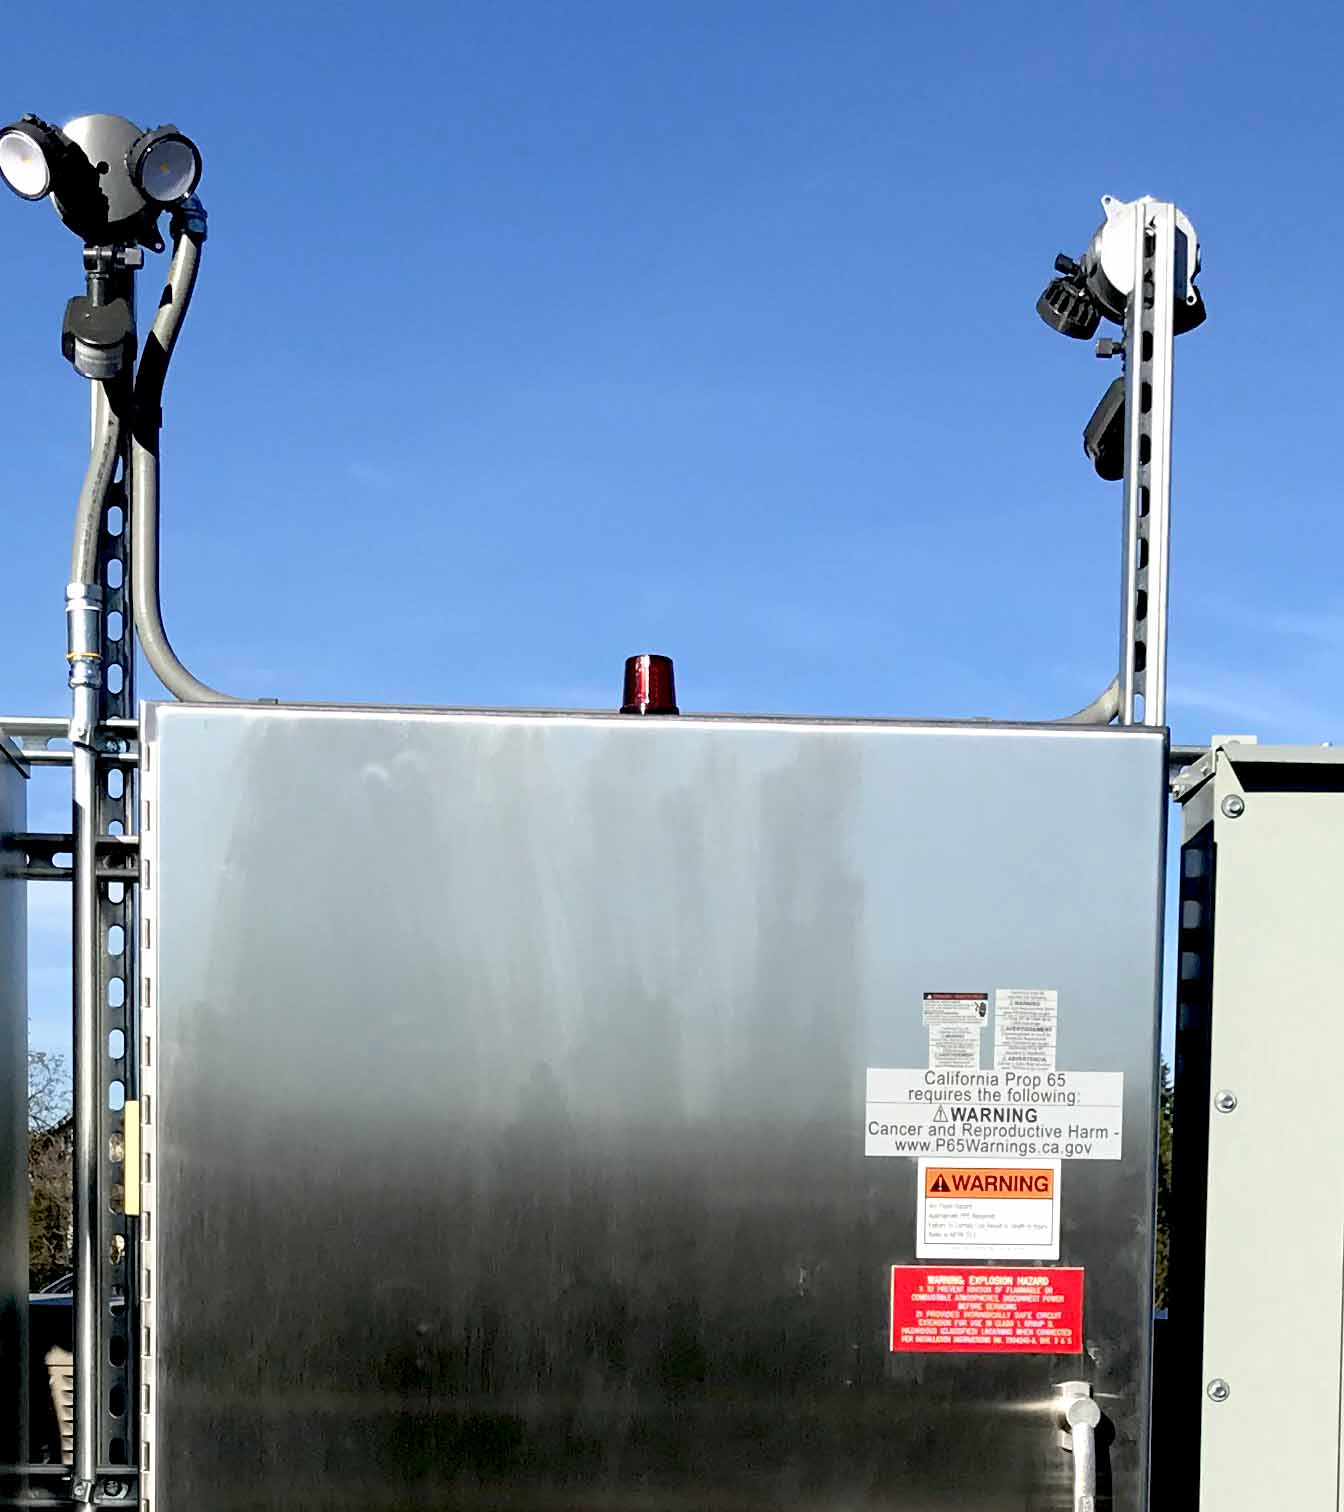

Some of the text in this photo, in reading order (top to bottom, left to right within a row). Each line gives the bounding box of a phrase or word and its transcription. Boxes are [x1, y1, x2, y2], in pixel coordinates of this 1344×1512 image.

[924, 1071, 1066, 1089] California Prop 65
[908, 1087, 1080, 1106] requires the following:
[951, 1107, 1038, 1123] WARNING
[868, 1121, 923, 1136] Cancer
[928, 1122, 955, 1137] and
[962, 1123, 1062, 1141] Reproductive
[1068, 1125, 1108, 1139] Harm
[895, 1139, 1092, 1157] www.P65Warnings.ca.gov
[952, 1175, 1049, 1192] WARNING
[969, 1276, 1013, 1285] EXPLOSION
[1017, 1276, 1049, 1286] HAZARD
